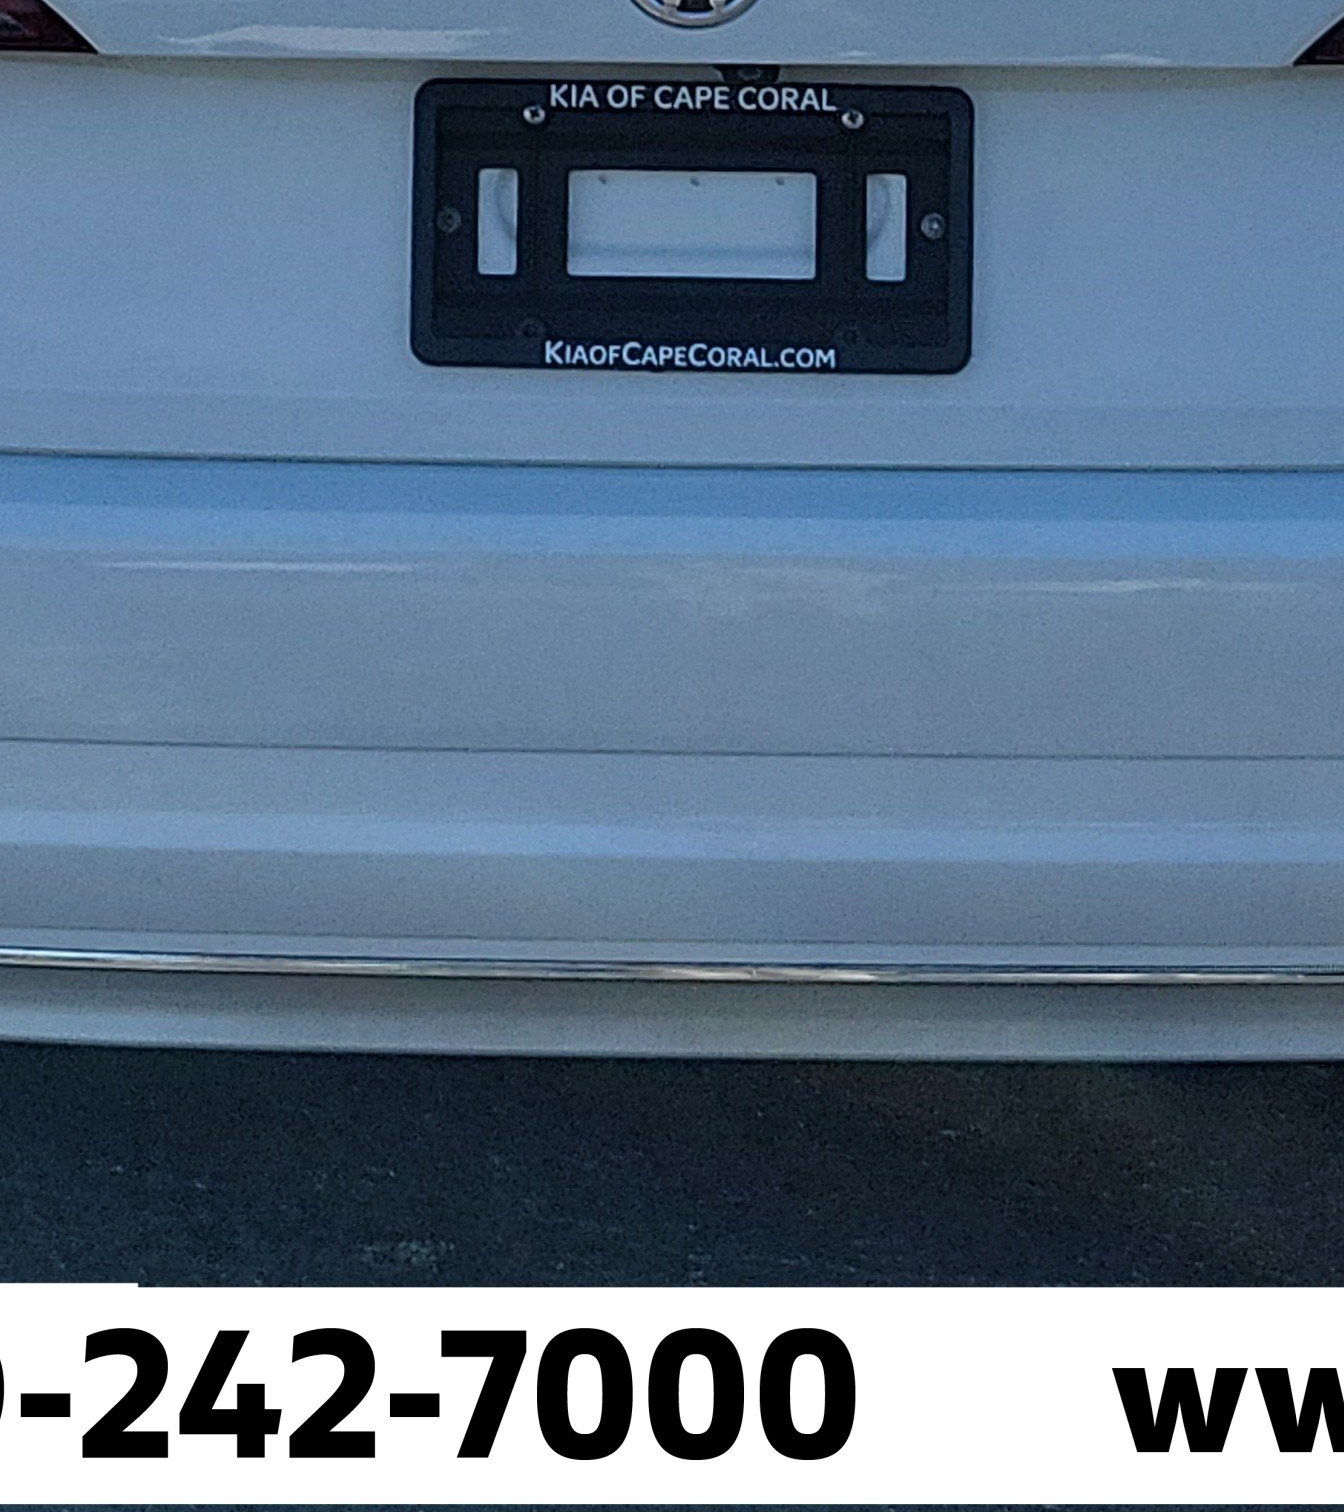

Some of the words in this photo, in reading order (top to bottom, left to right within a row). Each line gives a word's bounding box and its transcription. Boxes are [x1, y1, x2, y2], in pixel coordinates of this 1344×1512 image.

[550, 85, 600, 109] KIA
[607, 85, 646, 109] OF
[654, 86, 731, 111] CAPE
[737, 87, 838, 112] CORAL
